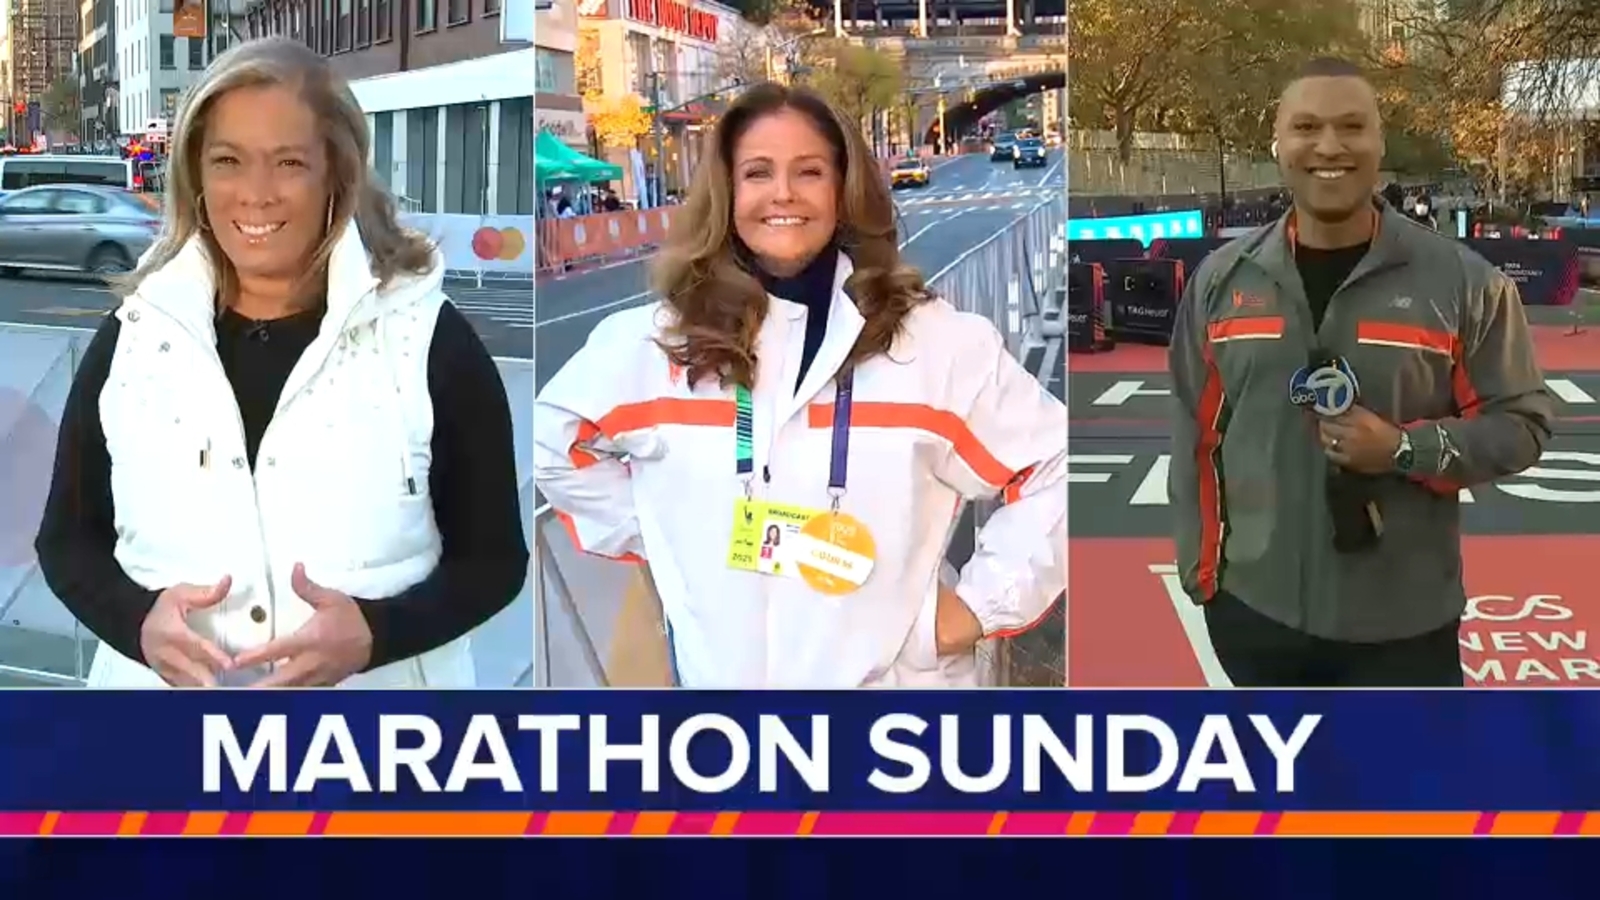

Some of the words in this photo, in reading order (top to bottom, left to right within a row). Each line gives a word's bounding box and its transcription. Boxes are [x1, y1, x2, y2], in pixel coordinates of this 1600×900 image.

[629, 0, 654, 22] THE
[689, 8, 719, 42] DEPOT
[1291, 391, 1316, 405] abc
[1307, 367, 1354, 415] 7
[1458, 630, 1587, 652] NEW
